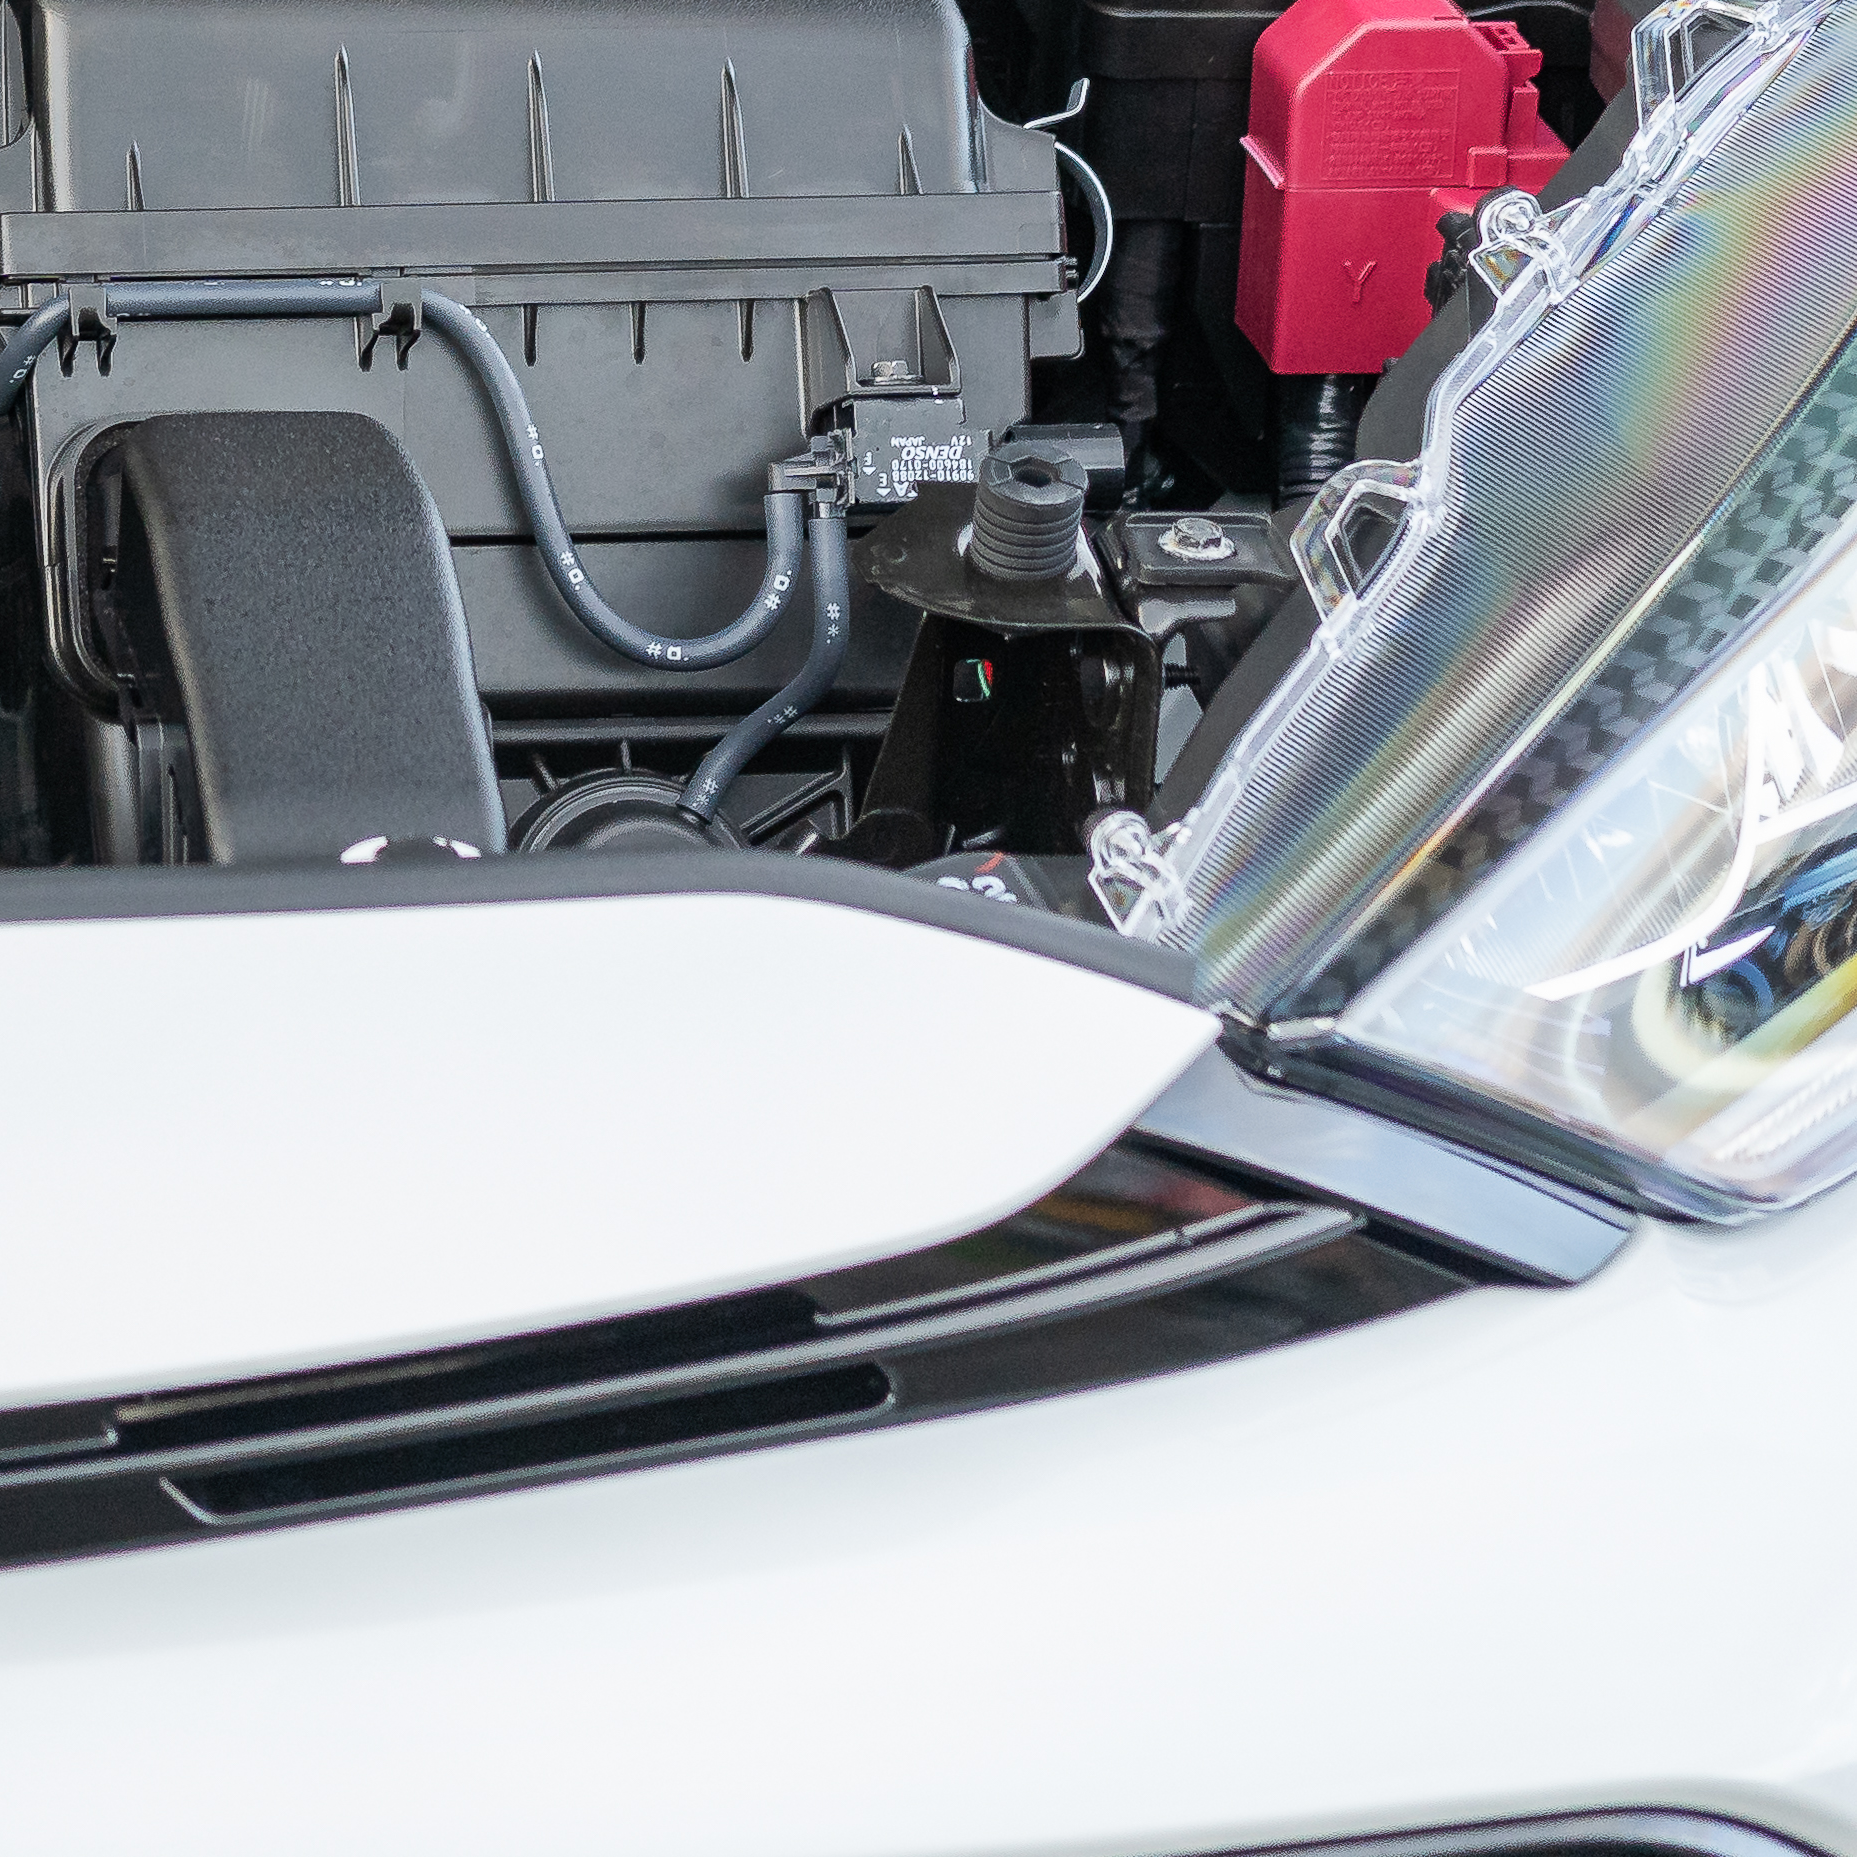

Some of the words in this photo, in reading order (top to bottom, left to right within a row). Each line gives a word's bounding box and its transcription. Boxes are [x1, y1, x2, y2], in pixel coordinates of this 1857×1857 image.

[1342, 259, 1378, 304] Y
[890, 435, 926, 447] JAPAN
[950, 435, 973, 447] 12V
[901, 446, 963, 461] DENSO
